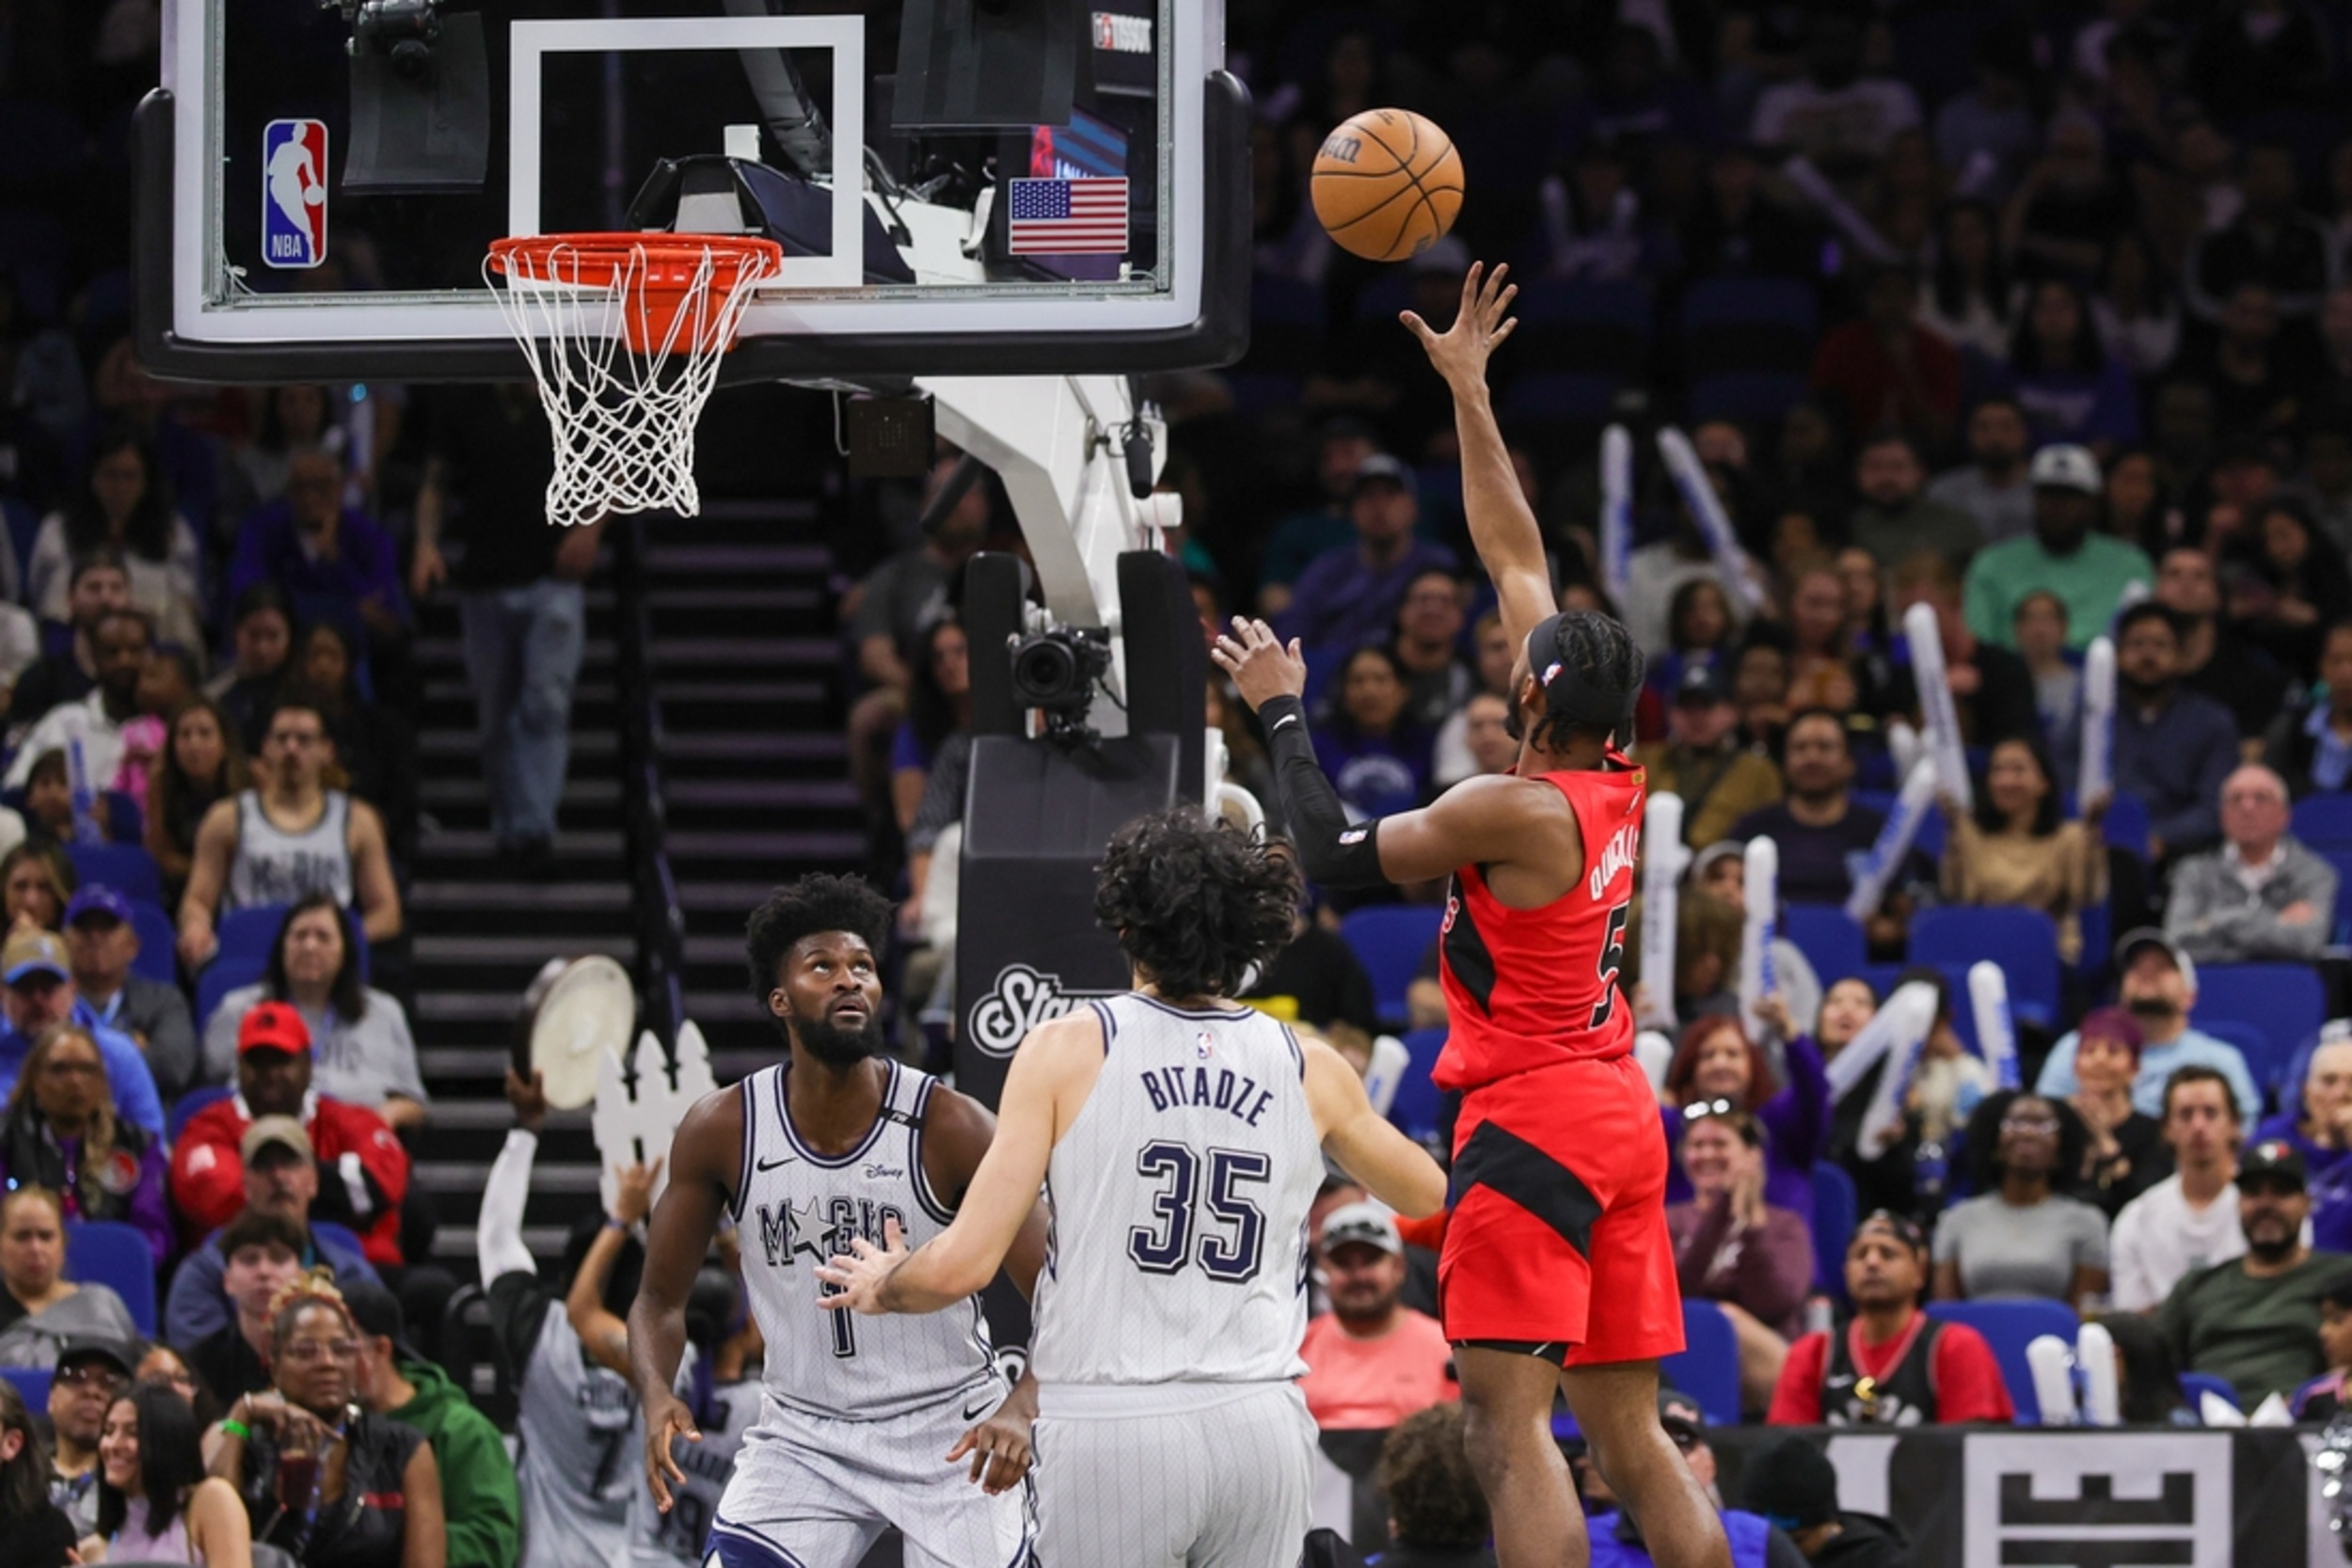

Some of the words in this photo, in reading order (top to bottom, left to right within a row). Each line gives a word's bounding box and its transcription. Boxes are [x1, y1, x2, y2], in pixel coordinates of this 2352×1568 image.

[271, 233, 303, 258] NBA
[1588, 898, 1630, 1031] 5
[1139, 1066, 1275, 1129] BITADZE
[862, 1163, 904, 1180] Disney
[1126, 1138, 1272, 1285] 35
